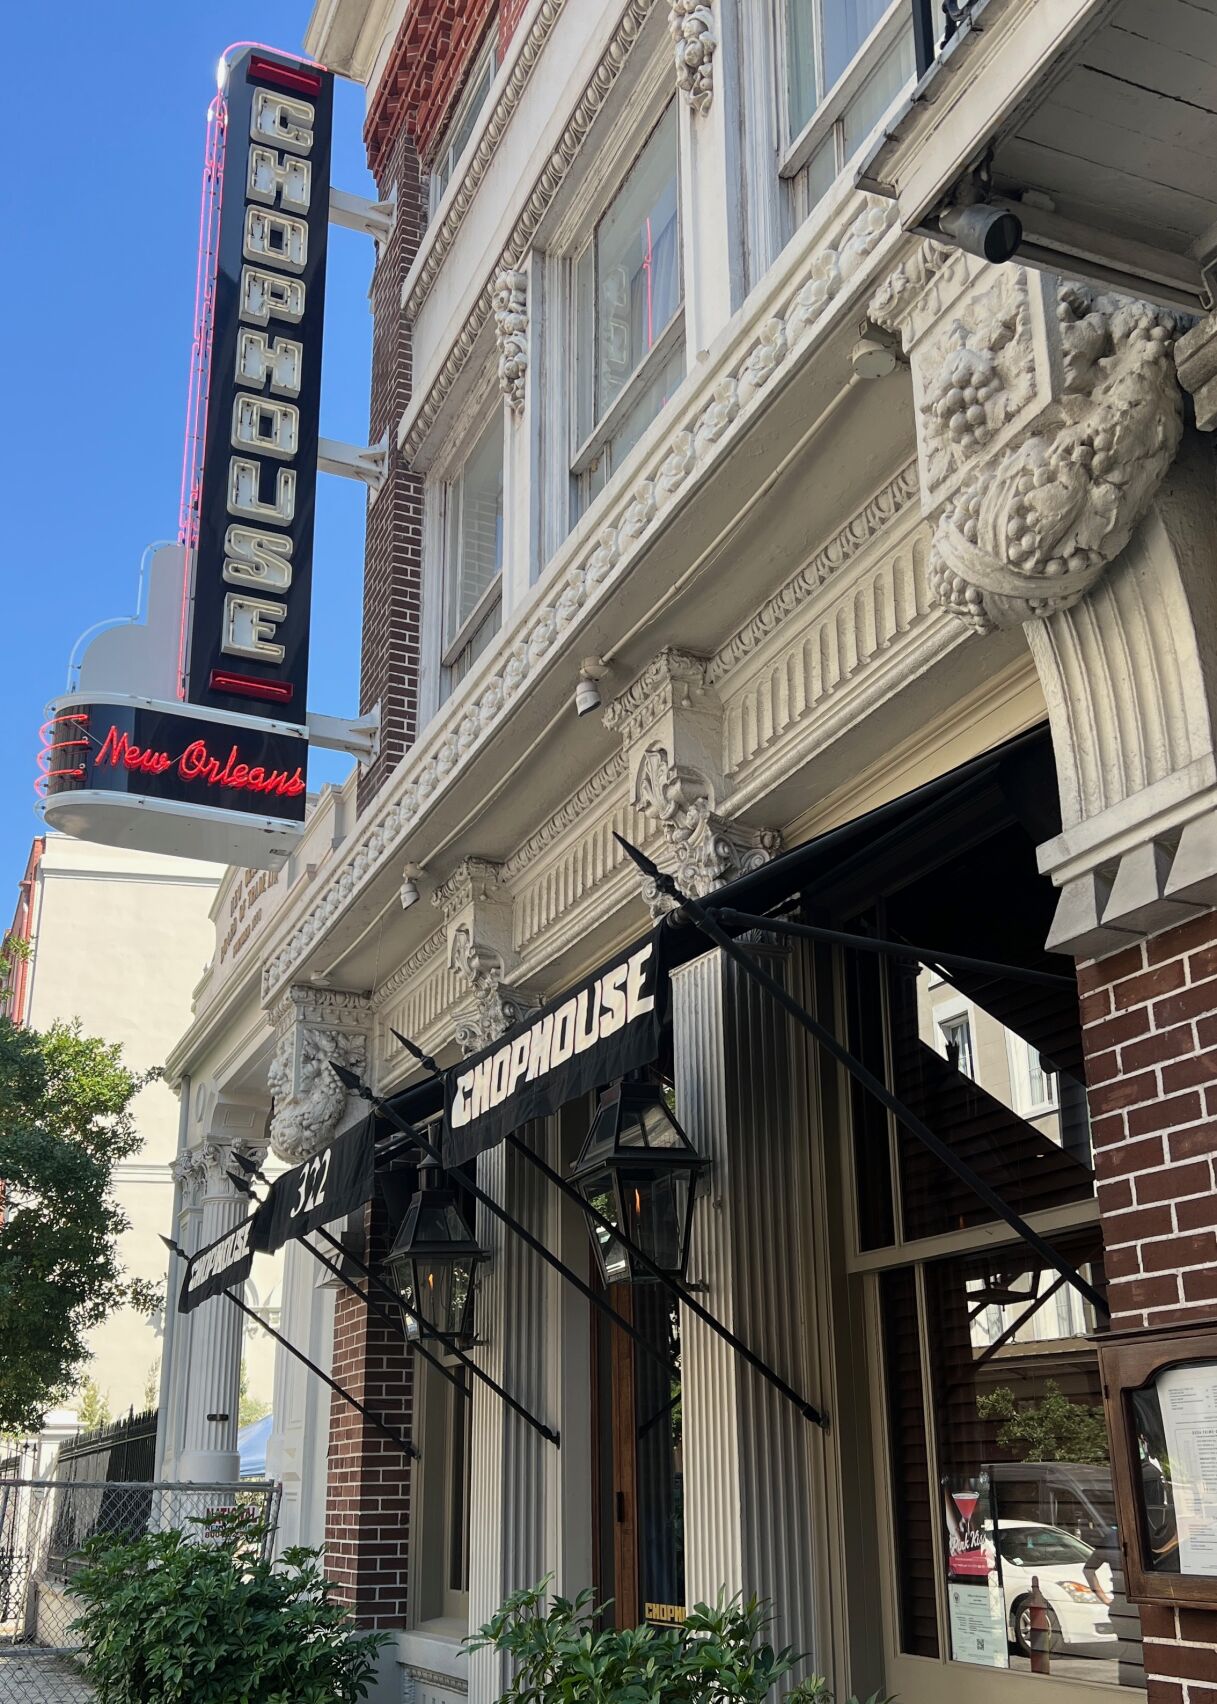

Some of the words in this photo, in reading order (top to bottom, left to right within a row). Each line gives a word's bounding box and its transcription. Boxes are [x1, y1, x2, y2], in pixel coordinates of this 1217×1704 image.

[221, 87, 315, 664] CHOPHOUSE
[95, 726, 172, 774] New
[178, 740, 305, 797] Orleans
[452, 942, 654, 1128] CHOPHOUSE
[290, 1148, 331, 1218] 322
[188, 1220, 253, 1292] CHOPHOUSE
